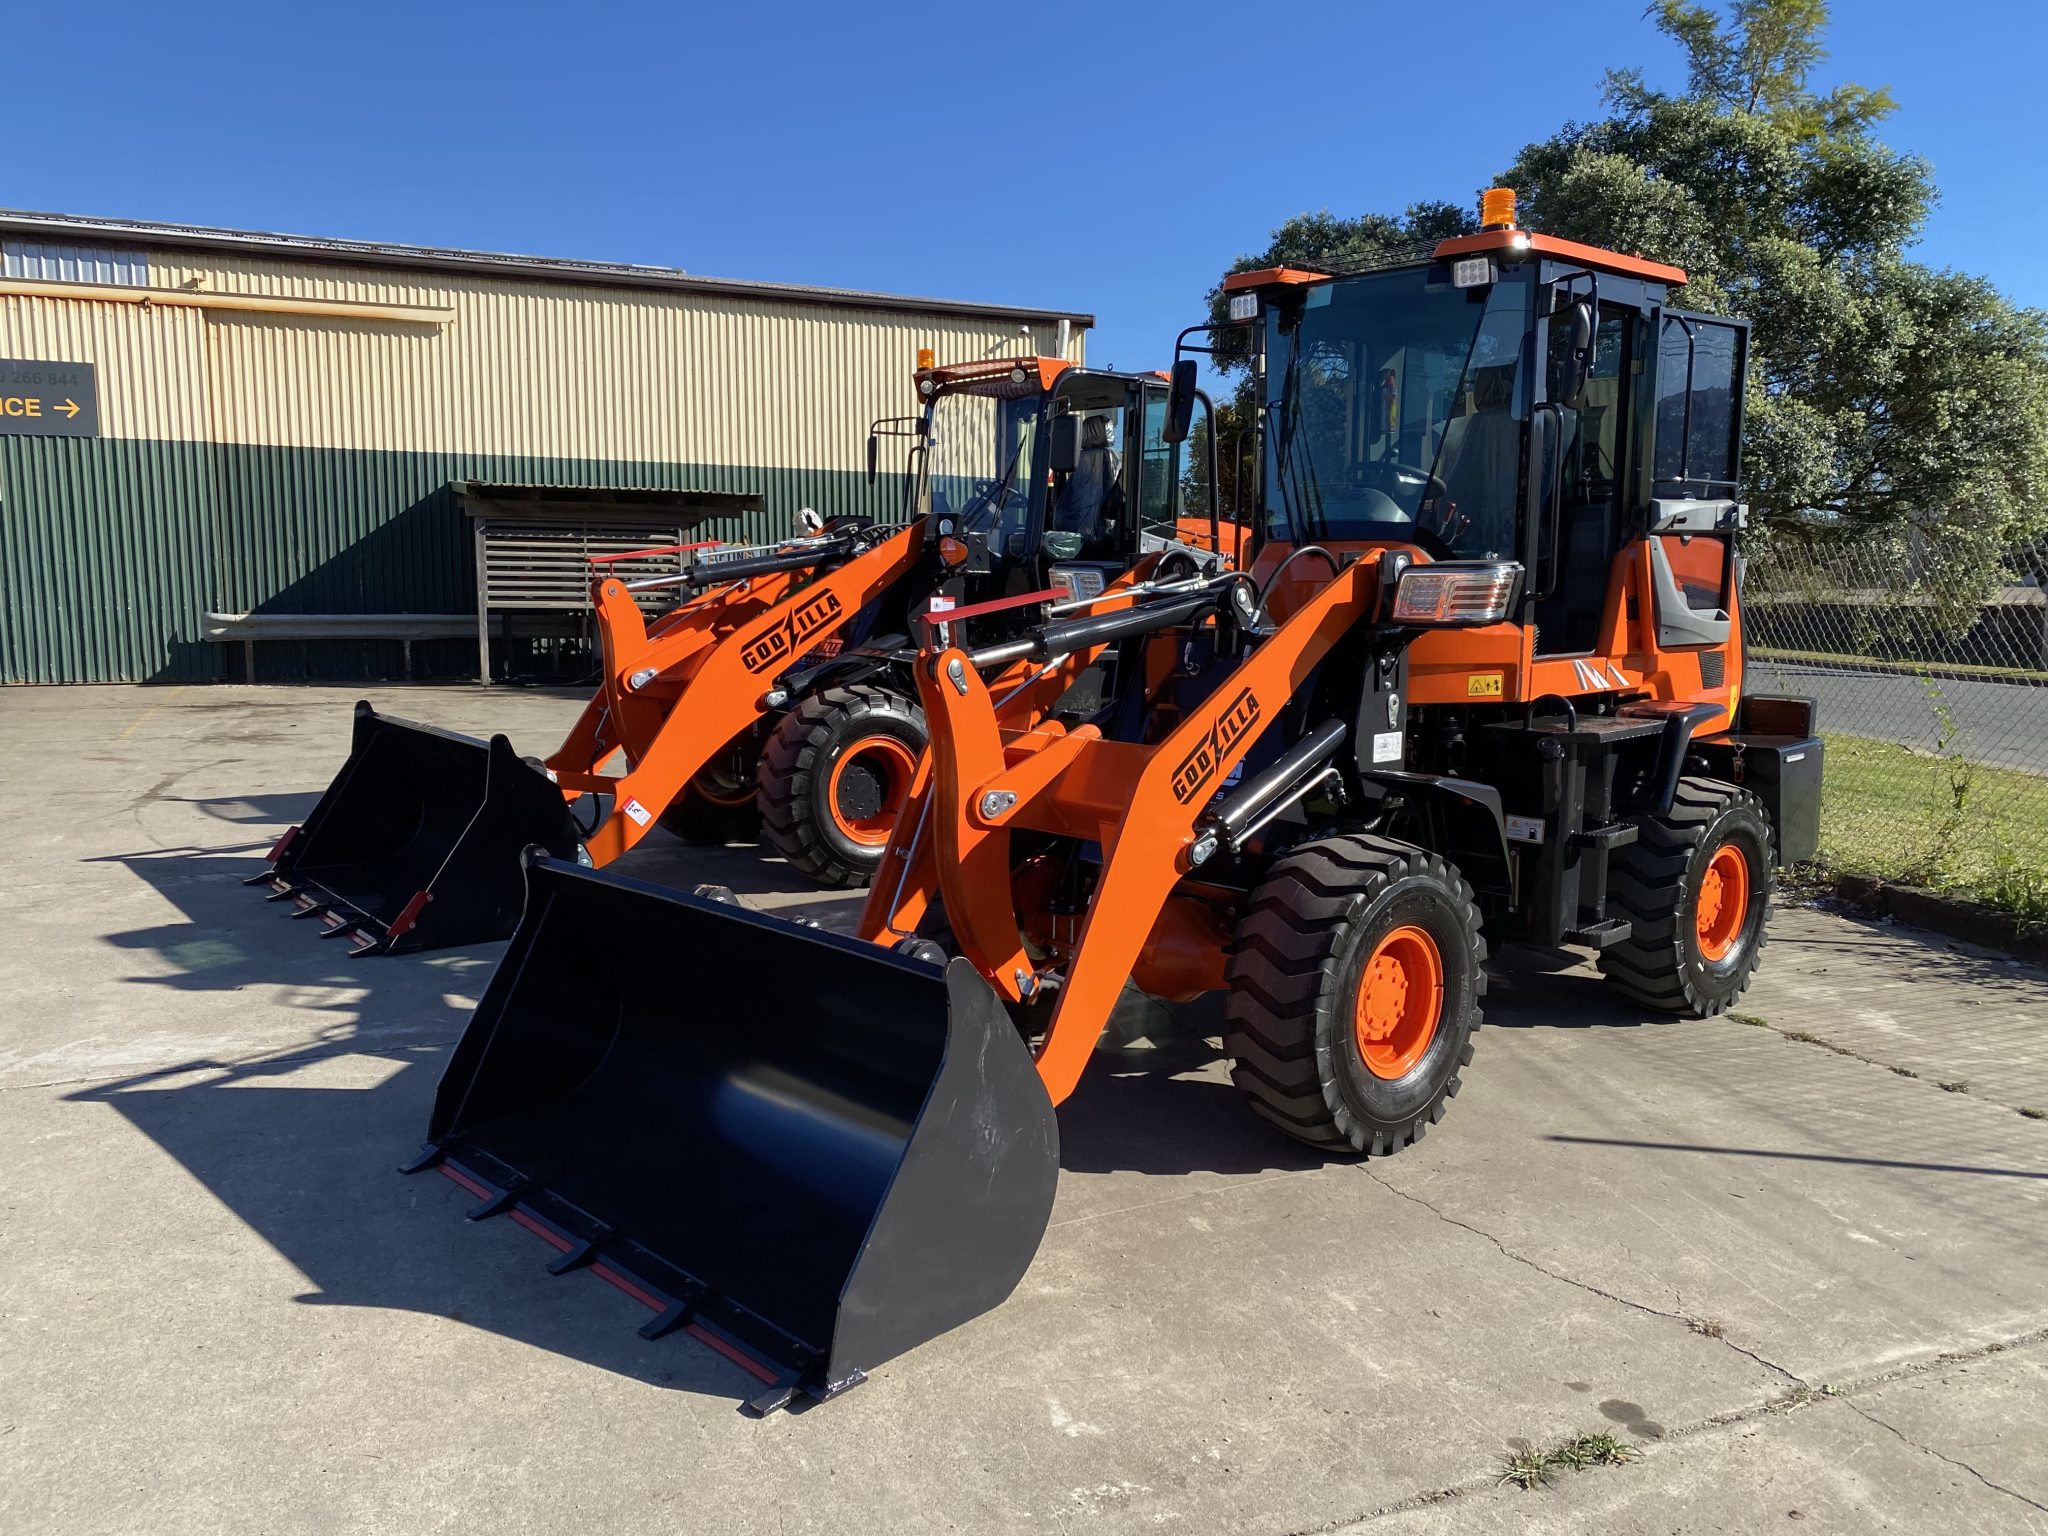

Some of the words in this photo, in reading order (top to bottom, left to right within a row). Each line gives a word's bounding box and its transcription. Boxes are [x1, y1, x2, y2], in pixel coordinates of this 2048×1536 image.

[12, 371, 42, 385] 266
[48, 373, 79, 386] 844
[741, 593, 842, 671] GODZILLA
[1172, 692, 1260, 803] GODZILLA
